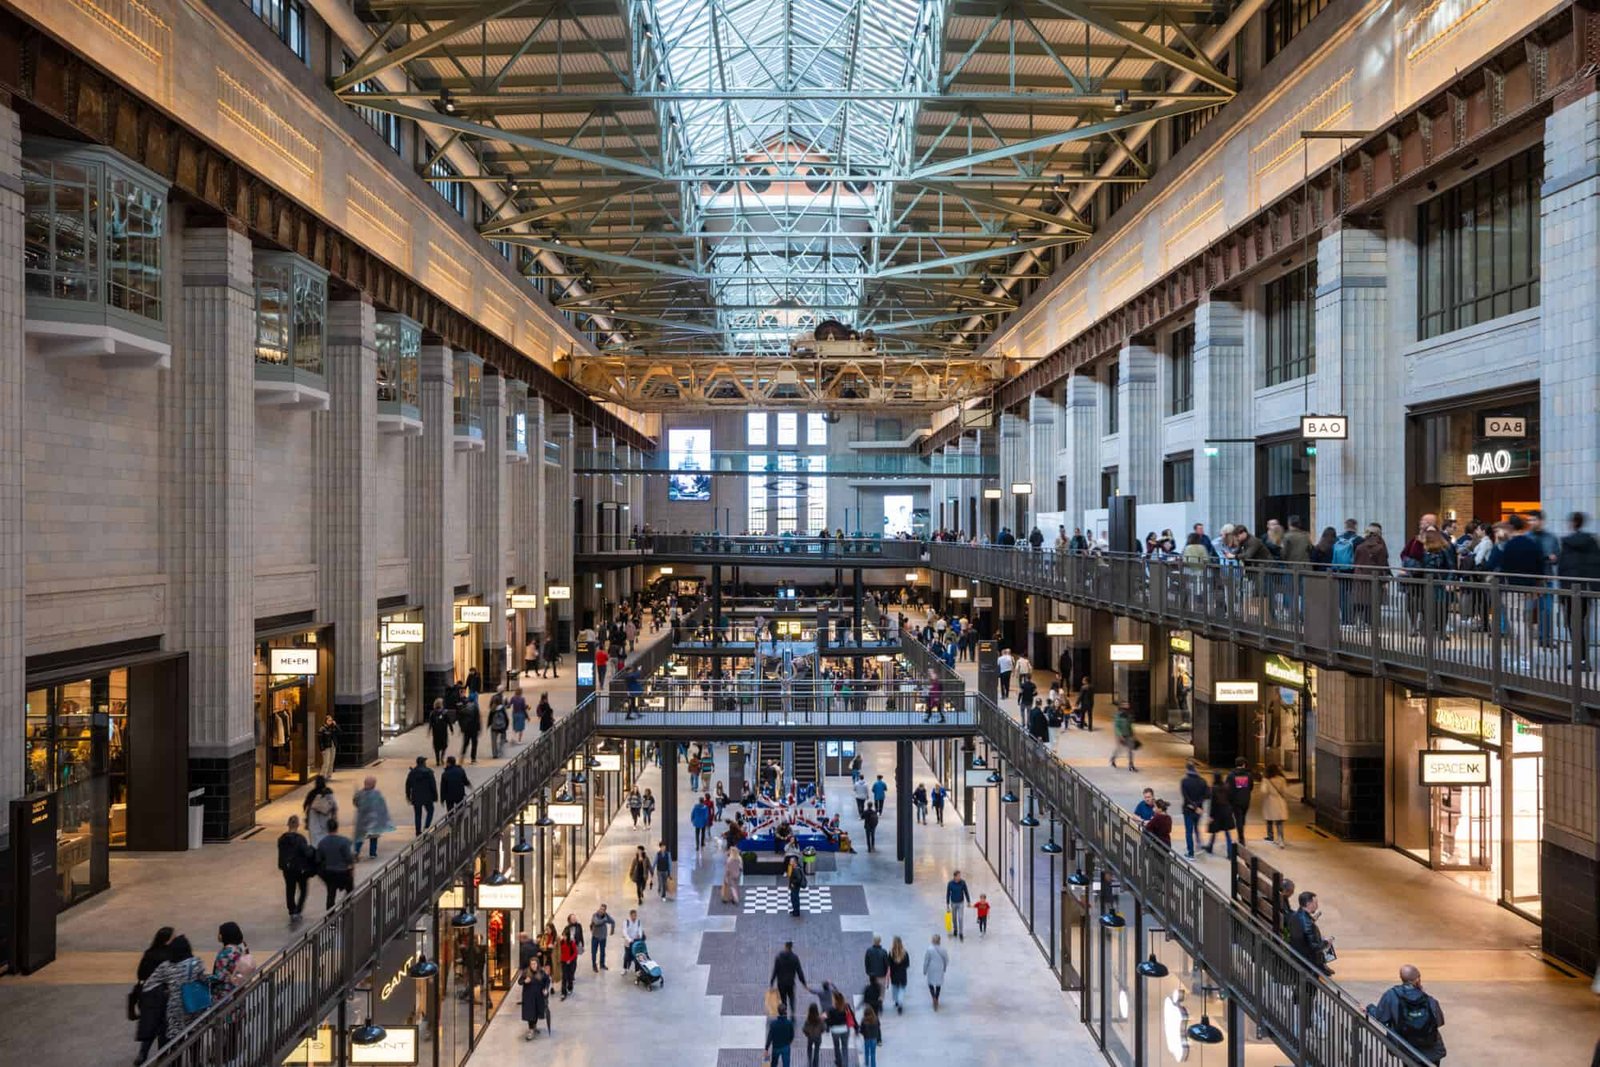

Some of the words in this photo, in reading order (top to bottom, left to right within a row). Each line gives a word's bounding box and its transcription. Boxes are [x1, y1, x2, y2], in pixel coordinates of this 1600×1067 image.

[1308, 422, 1341, 433] BAO
[1467, 450, 1511, 476] BAO
[280, 657, 309, 665] ME+EM
